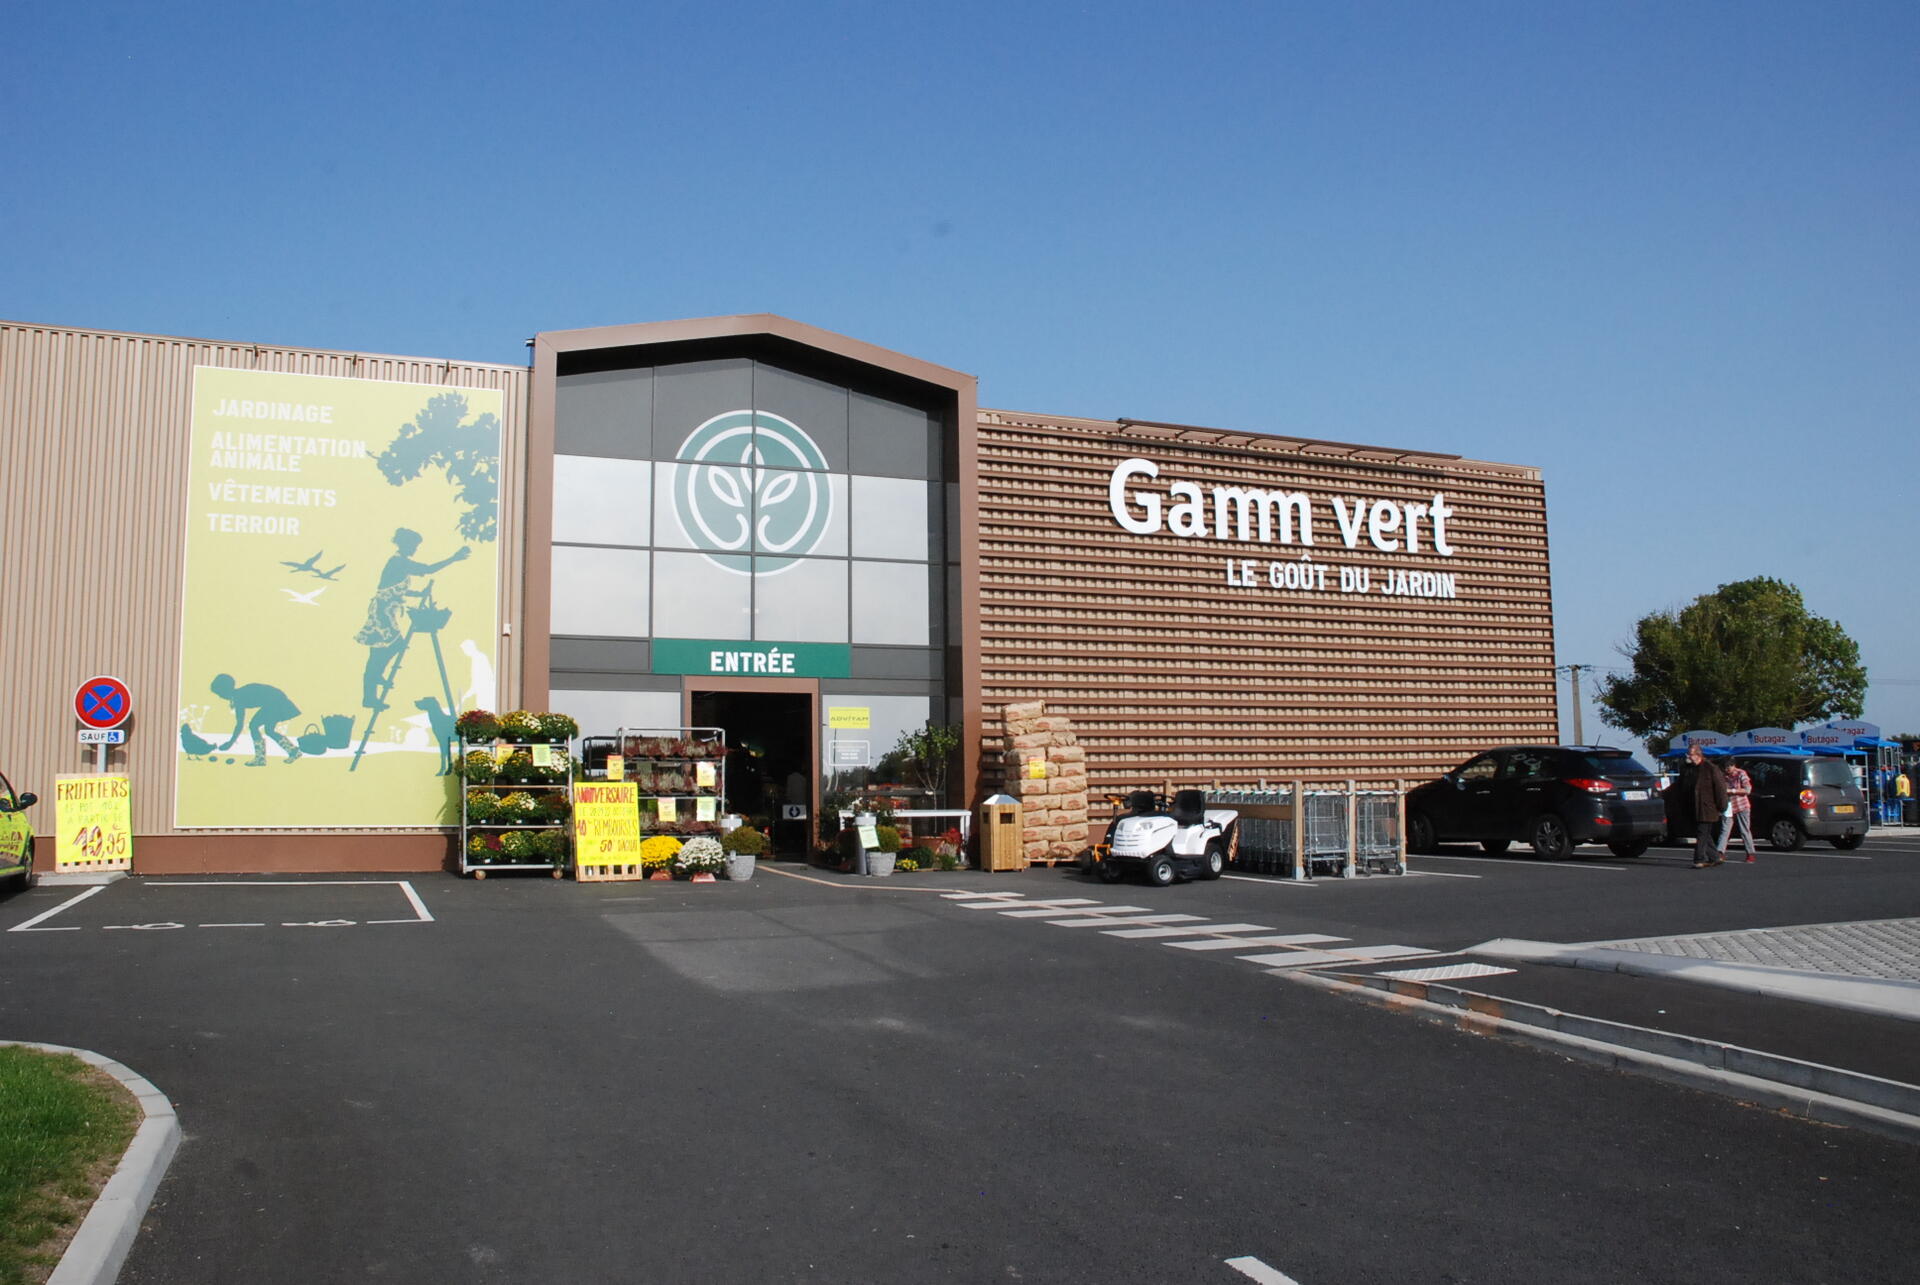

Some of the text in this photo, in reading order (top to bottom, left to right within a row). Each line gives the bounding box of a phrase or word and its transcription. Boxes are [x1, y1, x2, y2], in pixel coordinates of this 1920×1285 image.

[212, 399, 334, 424] JARDINAGE
[211, 431, 367, 459] ALIMENTATION
[209, 450, 302, 473] ANIMALE
[208, 479, 337, 508] VÊTEMENTS
[1109, 457, 1454, 556] Gamm vert
[207, 513, 301, 536] TERROIR
[1226, 553, 1456, 599] LE GOÛT DU JARDIN
[710, 647, 796, 674] ENTRÉE
[80, 732, 106, 741] SAUF
[1687, 737, 1717, 746] Butagaz
[1754, 735, 1786, 744] Butagaz
[1807, 735, 1840, 744] Butagaz
[57, 780, 128, 801] FRUITIERS
